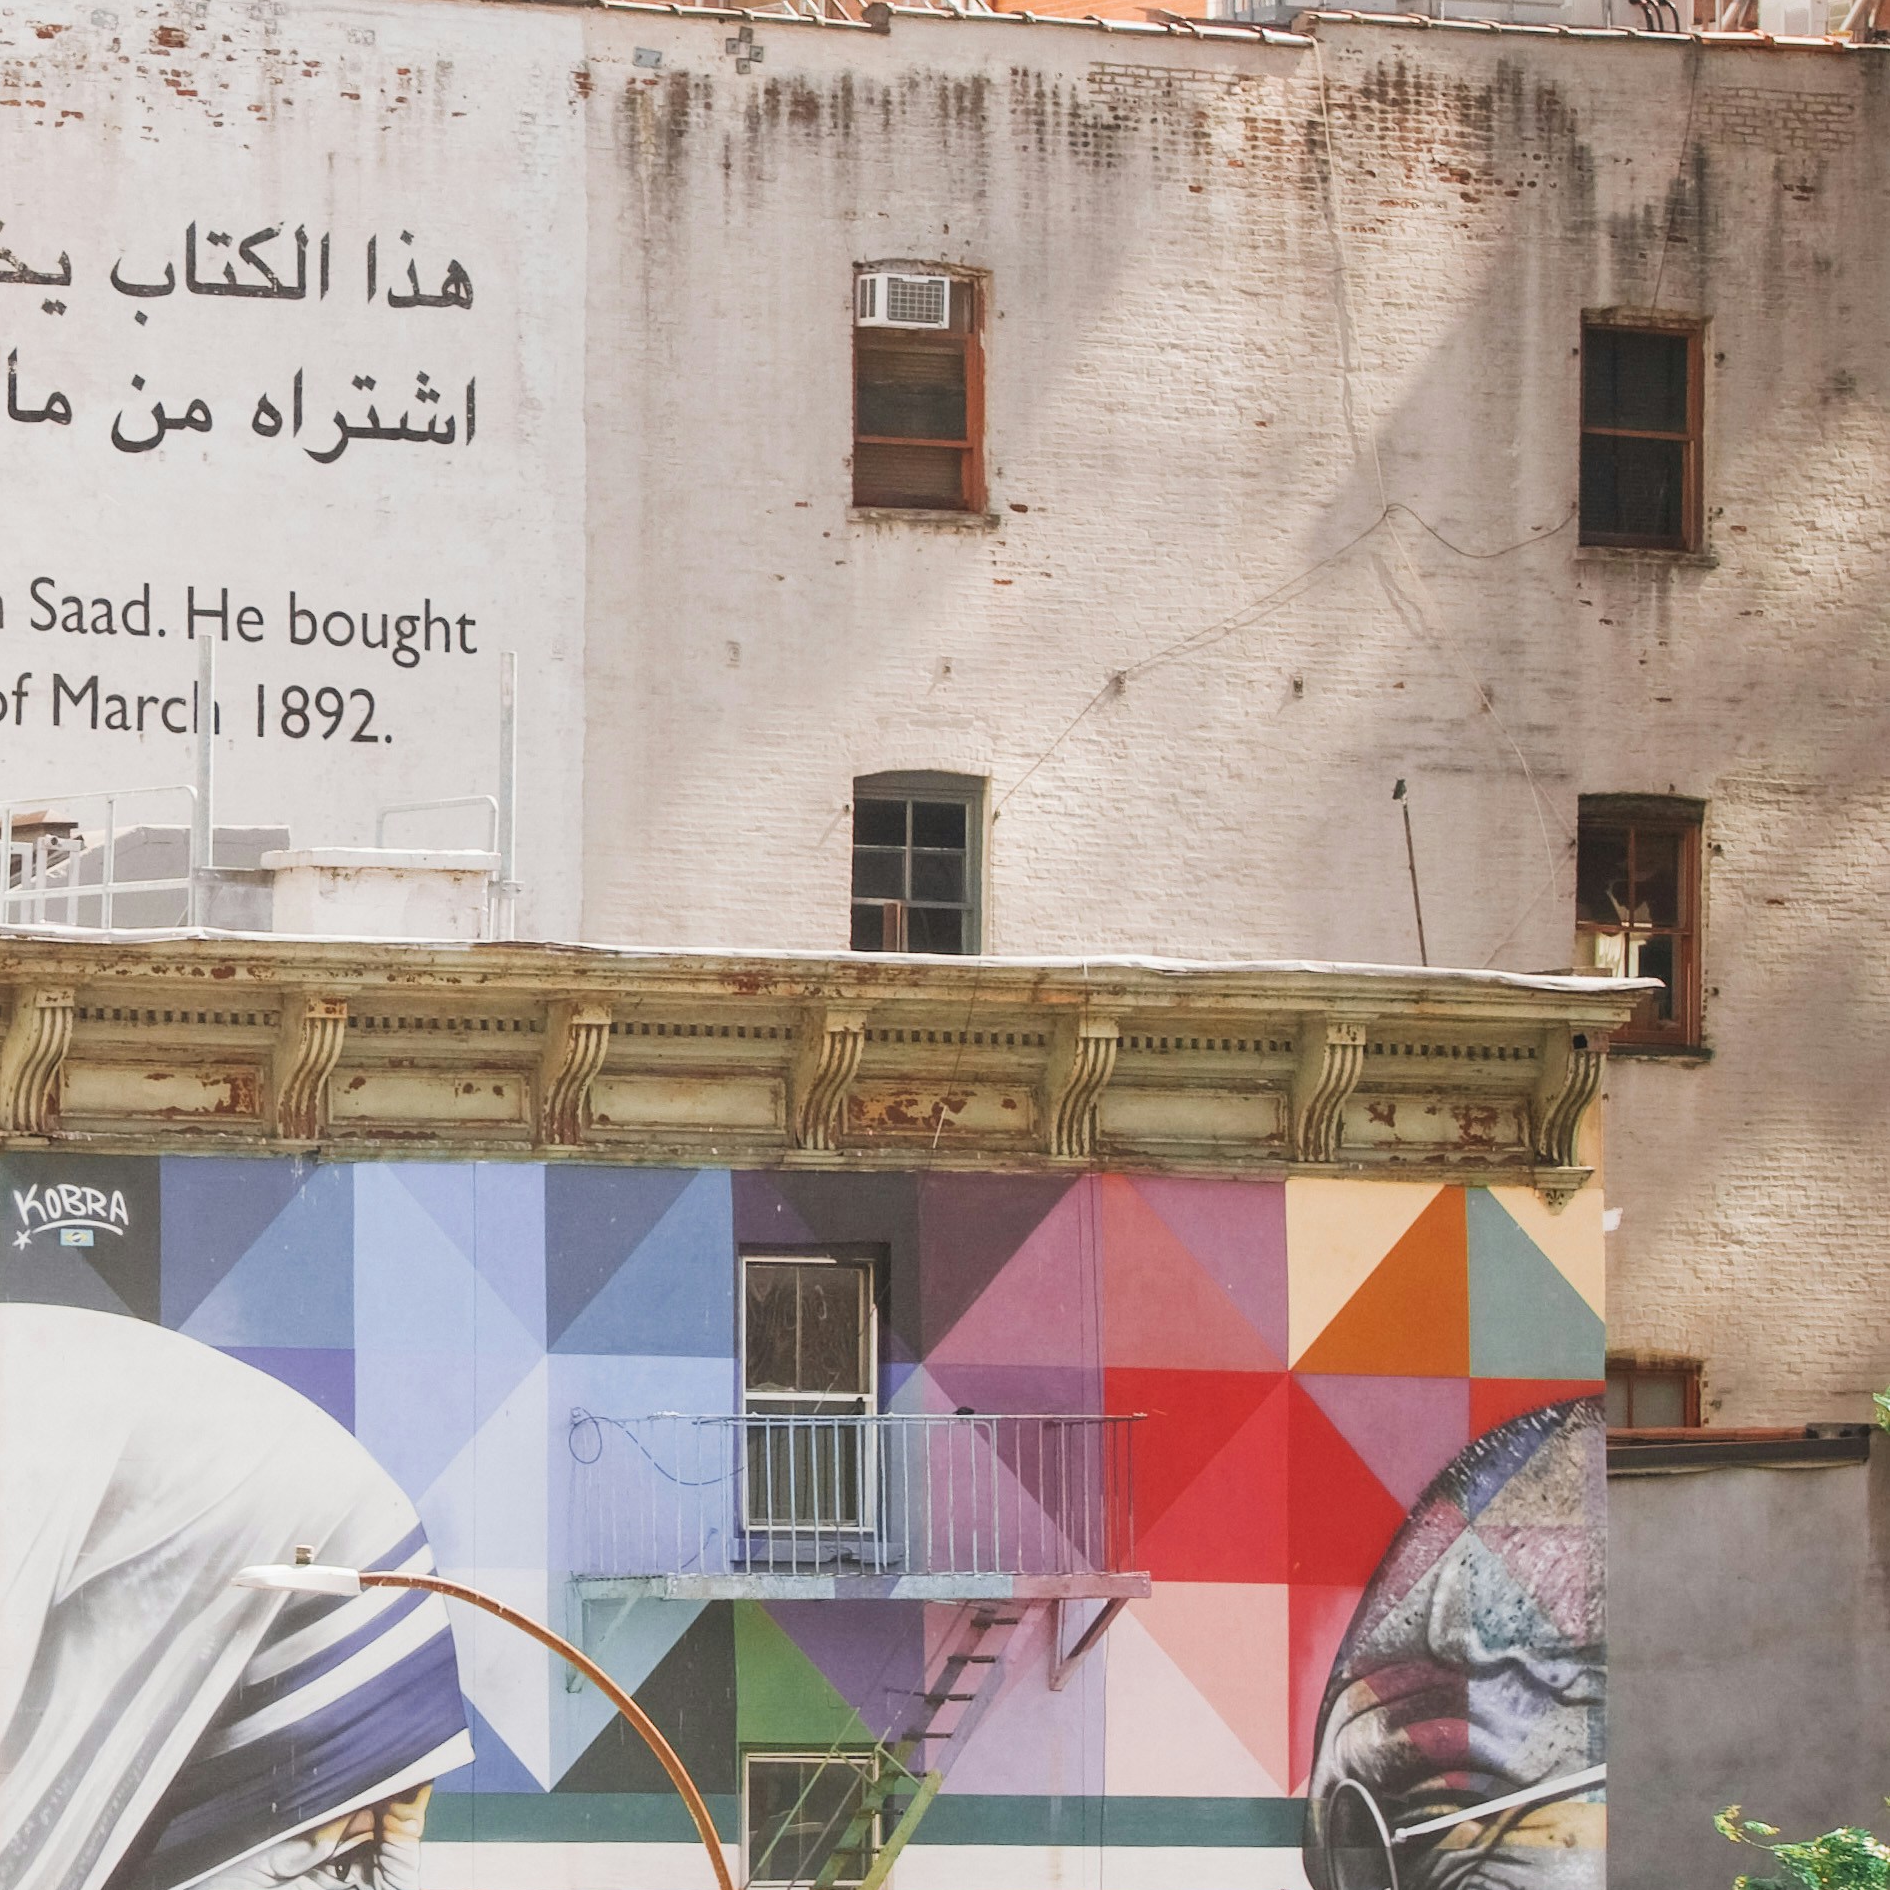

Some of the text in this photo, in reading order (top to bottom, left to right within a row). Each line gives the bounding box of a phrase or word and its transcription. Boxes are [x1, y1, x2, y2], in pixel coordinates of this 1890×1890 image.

[110, 220, 329, 325] الكتاب
[368, 229, 474, 310] هذا
[110, 374, 213, 453] من
[250, 368, 476, 464] اشتراه
[30, 576, 167, 638] Saad.
[187, 586, 265, 643] He
[289, 591, 478, 668] bought
[53, 673, 220, 735] March
[256, 683, 394, 744] 1892.
[13, 1183, 129, 1226] KOBRA
